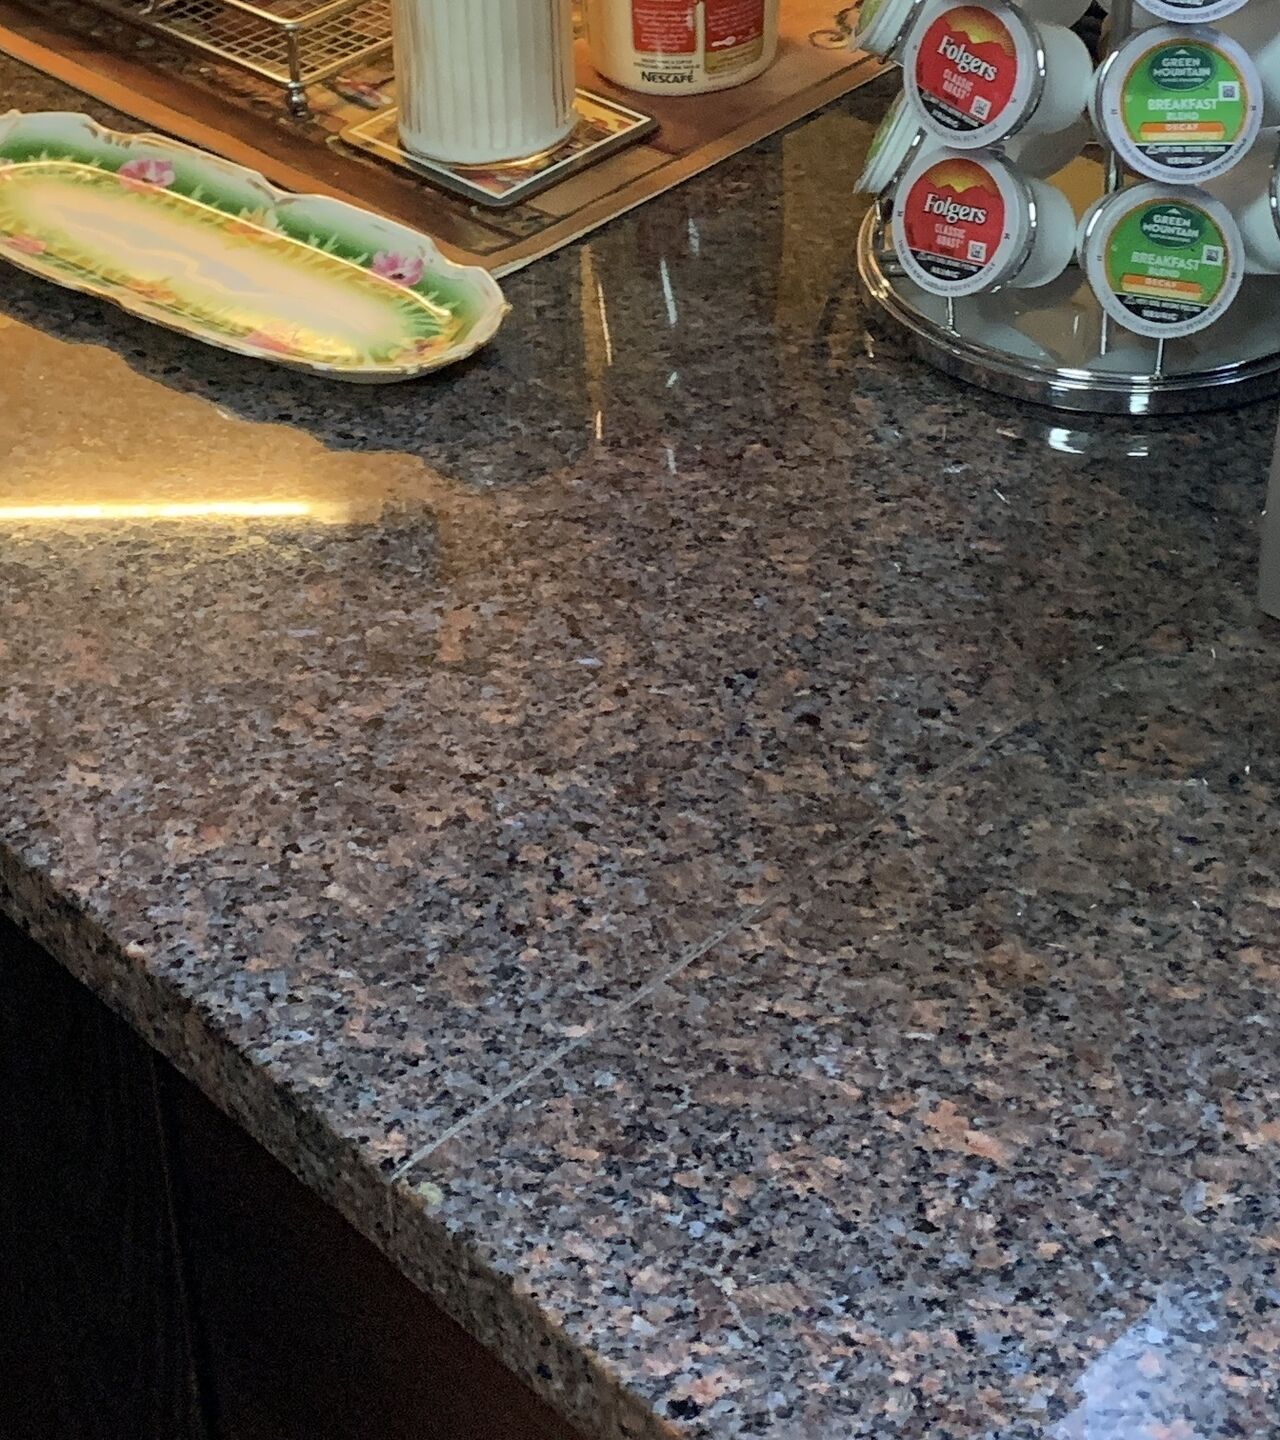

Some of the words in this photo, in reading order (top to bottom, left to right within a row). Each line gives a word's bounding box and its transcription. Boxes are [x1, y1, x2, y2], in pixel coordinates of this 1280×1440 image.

[937, 35, 997, 81] Folgers
[1162, 57, 1201, 67] GREEN
[1153, 67, 1211, 77] MOUNTAIN
[943, 69, 974, 91] CLASSIC
[1147, 98, 1218, 111] BREAKFAST
[1166, 112, 1199, 121] BLEND
[923, 193, 987, 224] Folgers
[1153, 214, 1191, 227] GREEN
[934, 223, 966, 239] CLASSIC
[1142, 223, 1200, 237] MOUNTAIN
[1131, 251, 1200, 271] BREAKFAST
